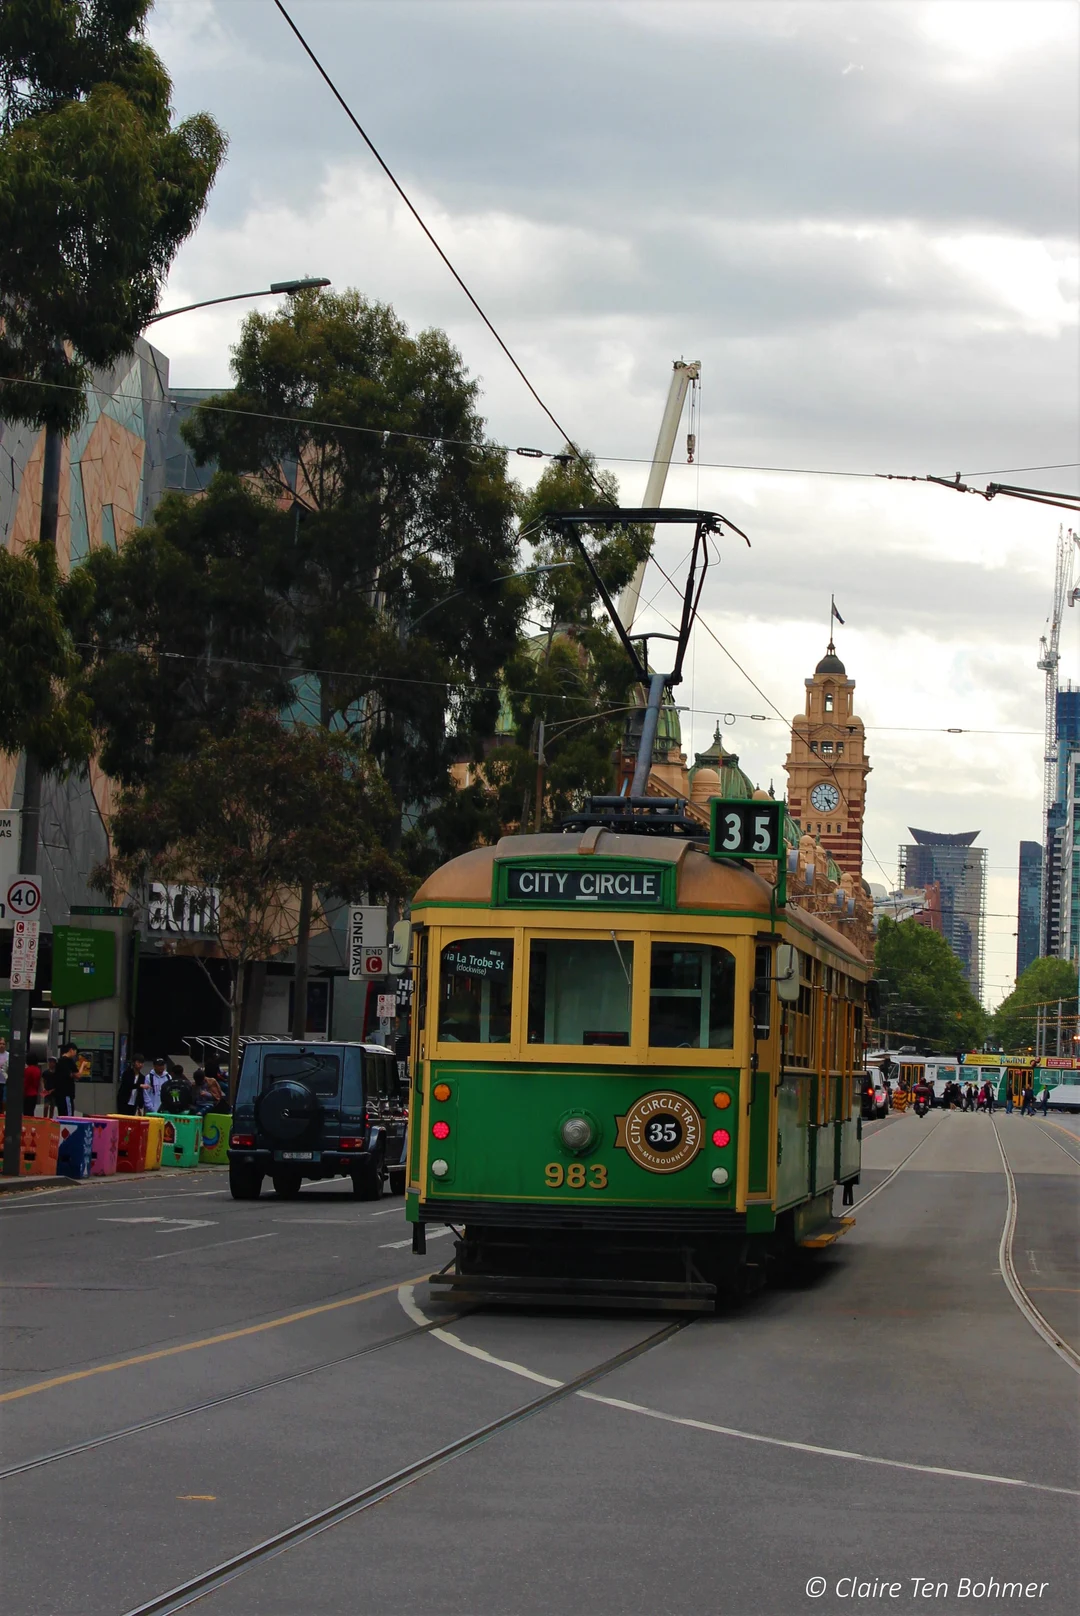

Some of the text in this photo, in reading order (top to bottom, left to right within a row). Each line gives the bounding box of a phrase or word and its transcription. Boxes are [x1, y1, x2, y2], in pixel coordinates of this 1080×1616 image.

[722, 813, 771, 852] 35
[519, 872, 656, 895] CITY CIRCLE
[11, 889, 36, 907] 40
[352, 911, 363, 976] CINEMAS
[456, 953, 466, 963] La
[470, 955, 493, 968] Trobe
[495, 960, 504, 970] St
[456, 964, 487, 976] (clockwise)
[630, 1098, 696, 1146] CITY CIRCLE TRAM
[649, 1122, 677, 1142] 35
[642, 1151, 684, 1164] MELBOURNE
[544, 1162, 608, 1188] 983
